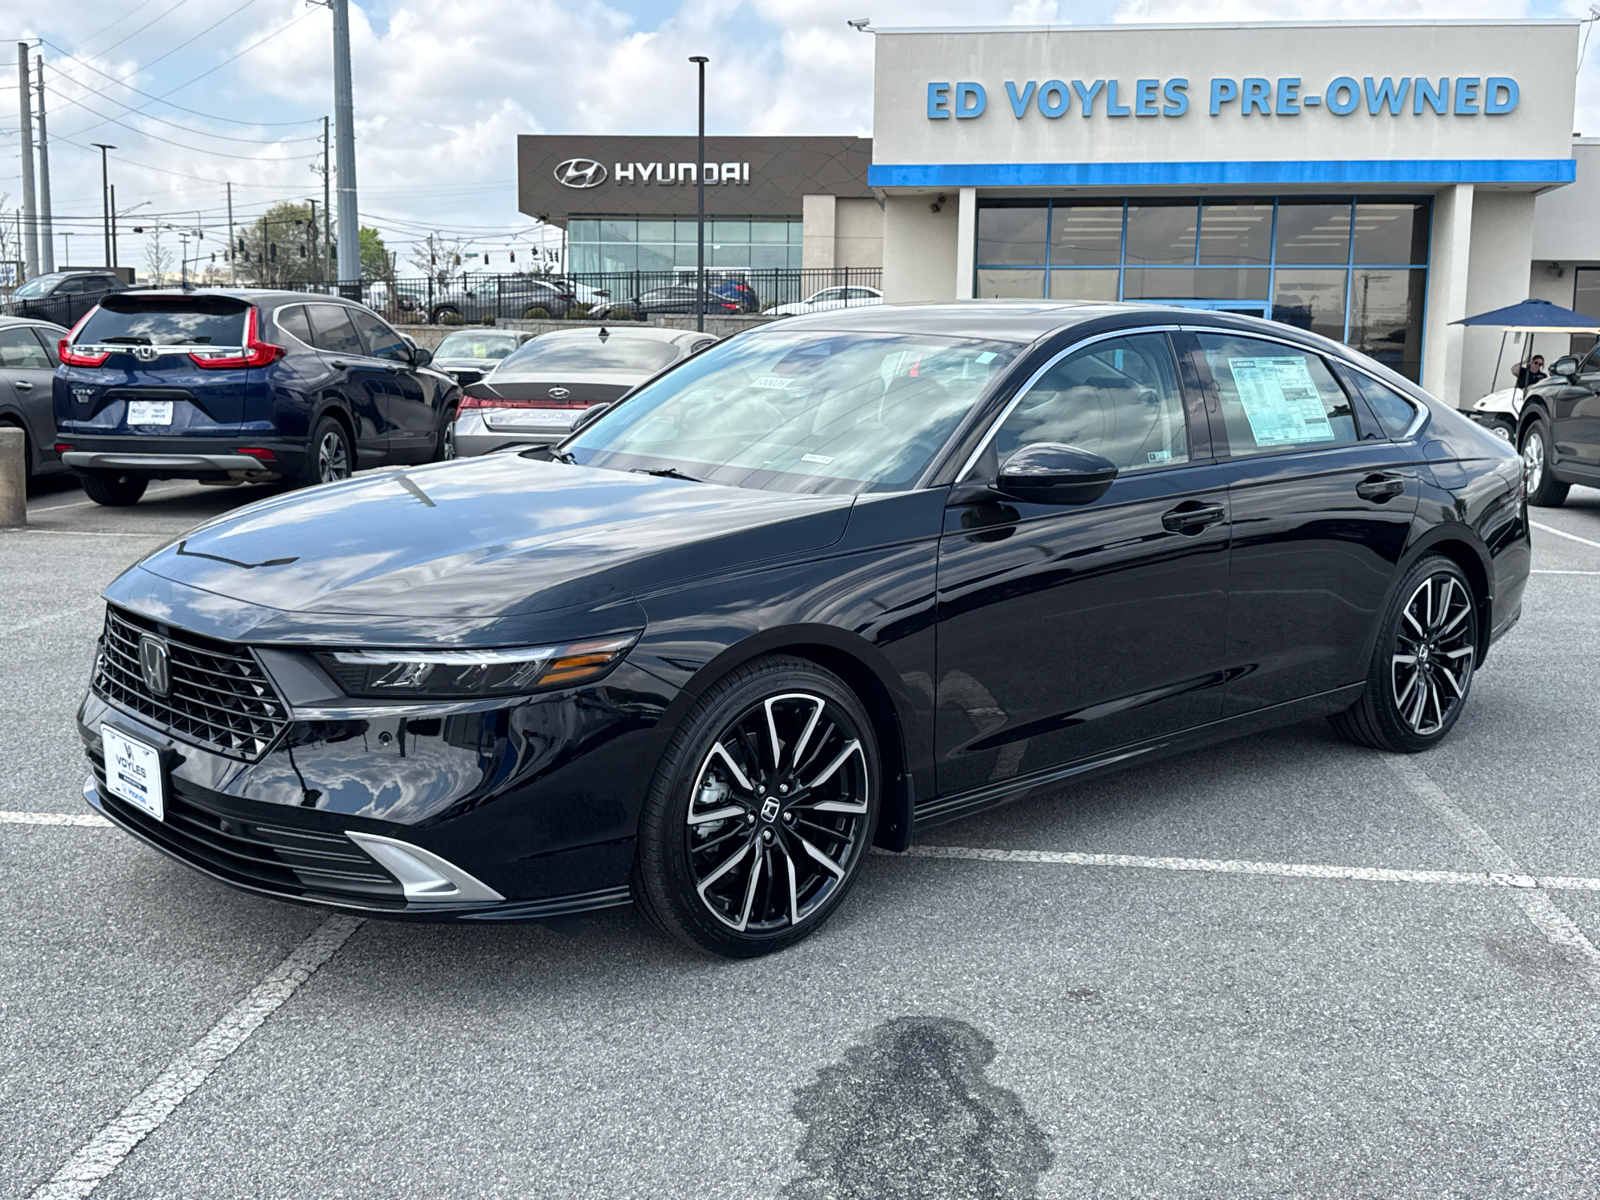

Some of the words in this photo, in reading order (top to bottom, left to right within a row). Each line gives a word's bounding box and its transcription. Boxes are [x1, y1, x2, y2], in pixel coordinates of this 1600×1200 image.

[927, 81, 987, 119] ED
[1004, 78, 1189, 119] VOYLES
[1209, 76, 1521, 116] PRE-OWNED
[615, 162, 750, 186] HYUNDAI
[116, 754, 146, 778] VOYLES
